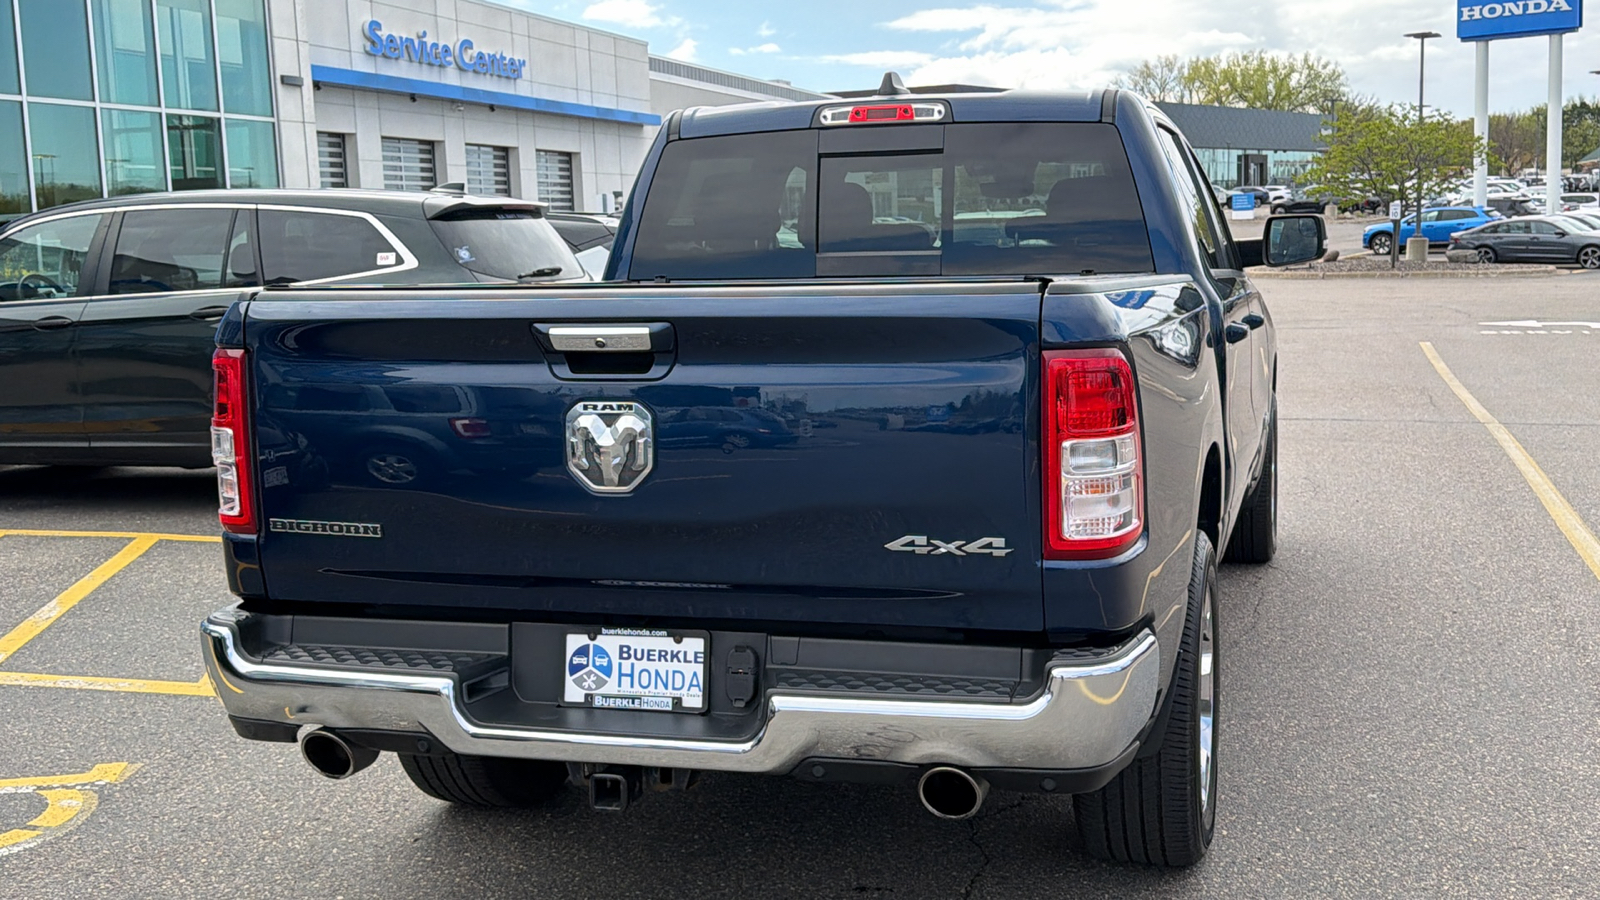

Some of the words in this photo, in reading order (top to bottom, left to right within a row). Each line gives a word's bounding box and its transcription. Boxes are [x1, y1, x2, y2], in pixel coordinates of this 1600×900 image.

[1460, 0, 1572, 21] HONDA
[364, 19, 453, 67] Service
[455, 38, 527, 79] Center
[582, 403, 634, 411] RAM
[269, 518, 382, 537] BIGHORN
[883, 535, 1015, 557] 4x4
[601, 627, 668, 636] buerklehonda.com
[618, 644, 704, 663] BUERKLE
[617, 662, 702, 691] HONDA
[595, 696, 641, 707] BUERKLE
[642, 697, 670, 708] HONDA
